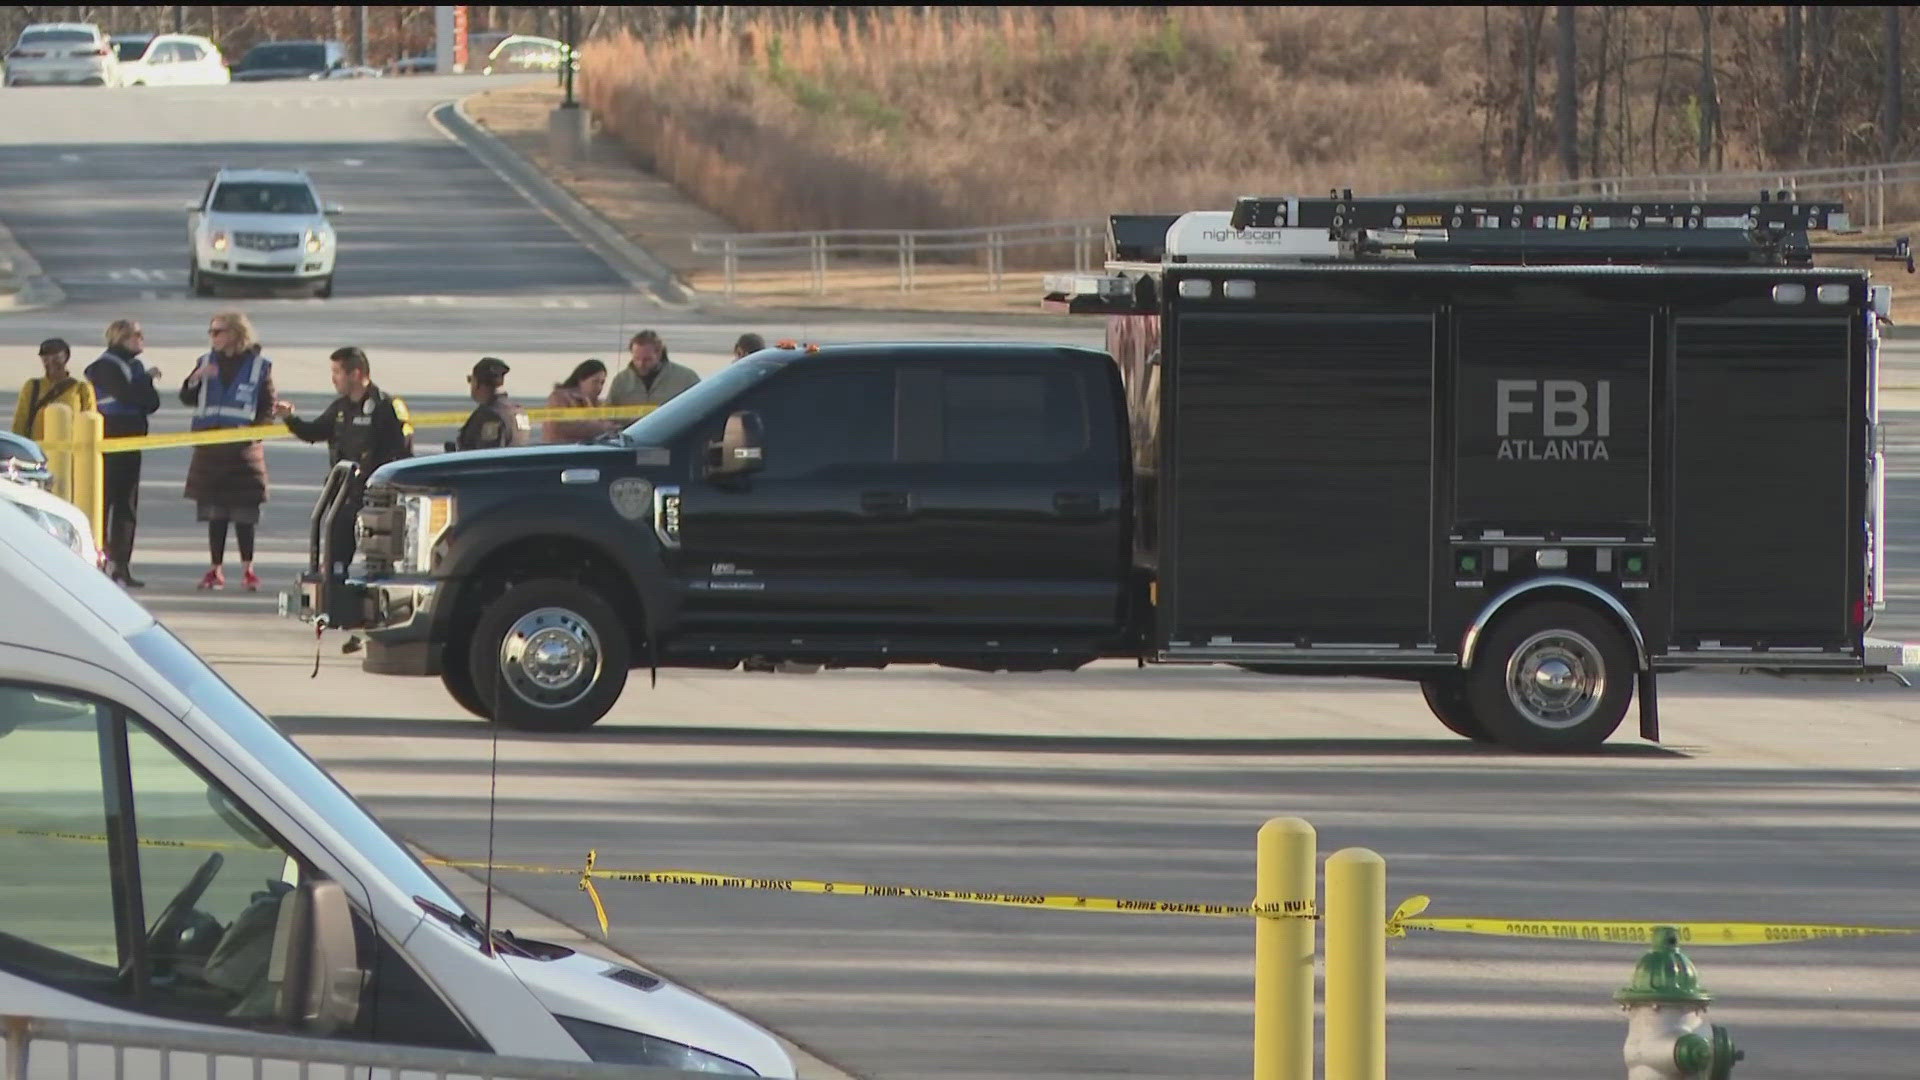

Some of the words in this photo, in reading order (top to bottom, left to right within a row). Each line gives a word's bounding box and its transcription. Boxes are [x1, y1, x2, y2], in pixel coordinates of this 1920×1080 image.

[1497, 380, 1610, 436] FBI
[1497, 440, 1609, 460] ATLANTA
[864, 885, 905, 897] CRIME
